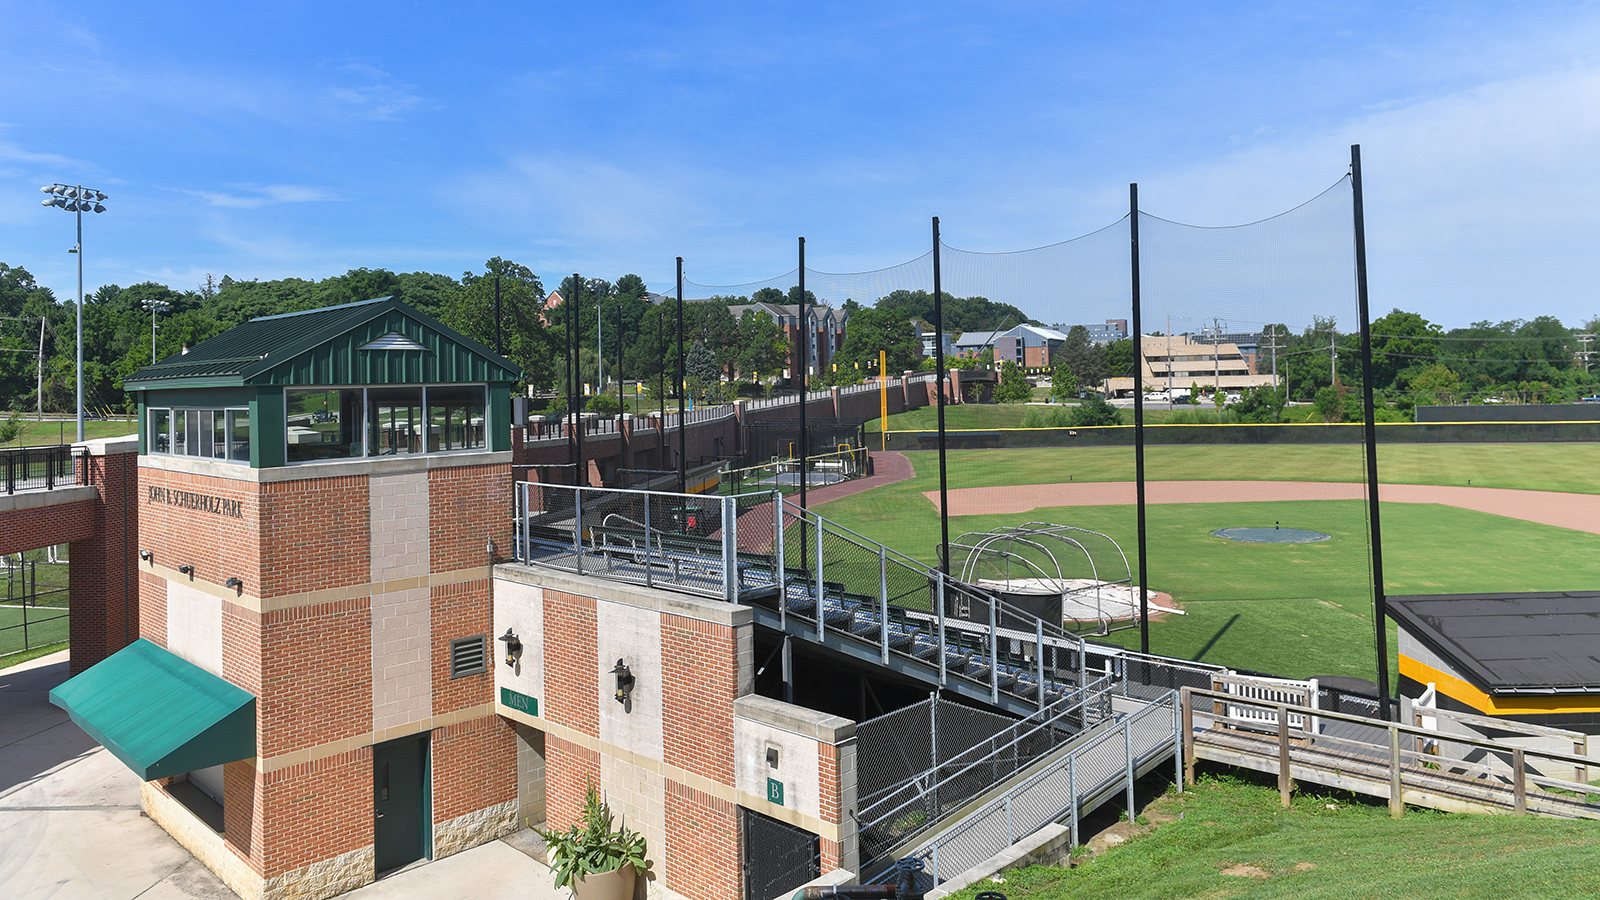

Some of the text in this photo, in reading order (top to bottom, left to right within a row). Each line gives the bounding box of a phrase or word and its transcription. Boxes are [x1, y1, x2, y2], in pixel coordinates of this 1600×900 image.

[222, 498, 243, 519] PARK
[509, 692, 529, 710] MEN
[771, 782, 779, 799] B
